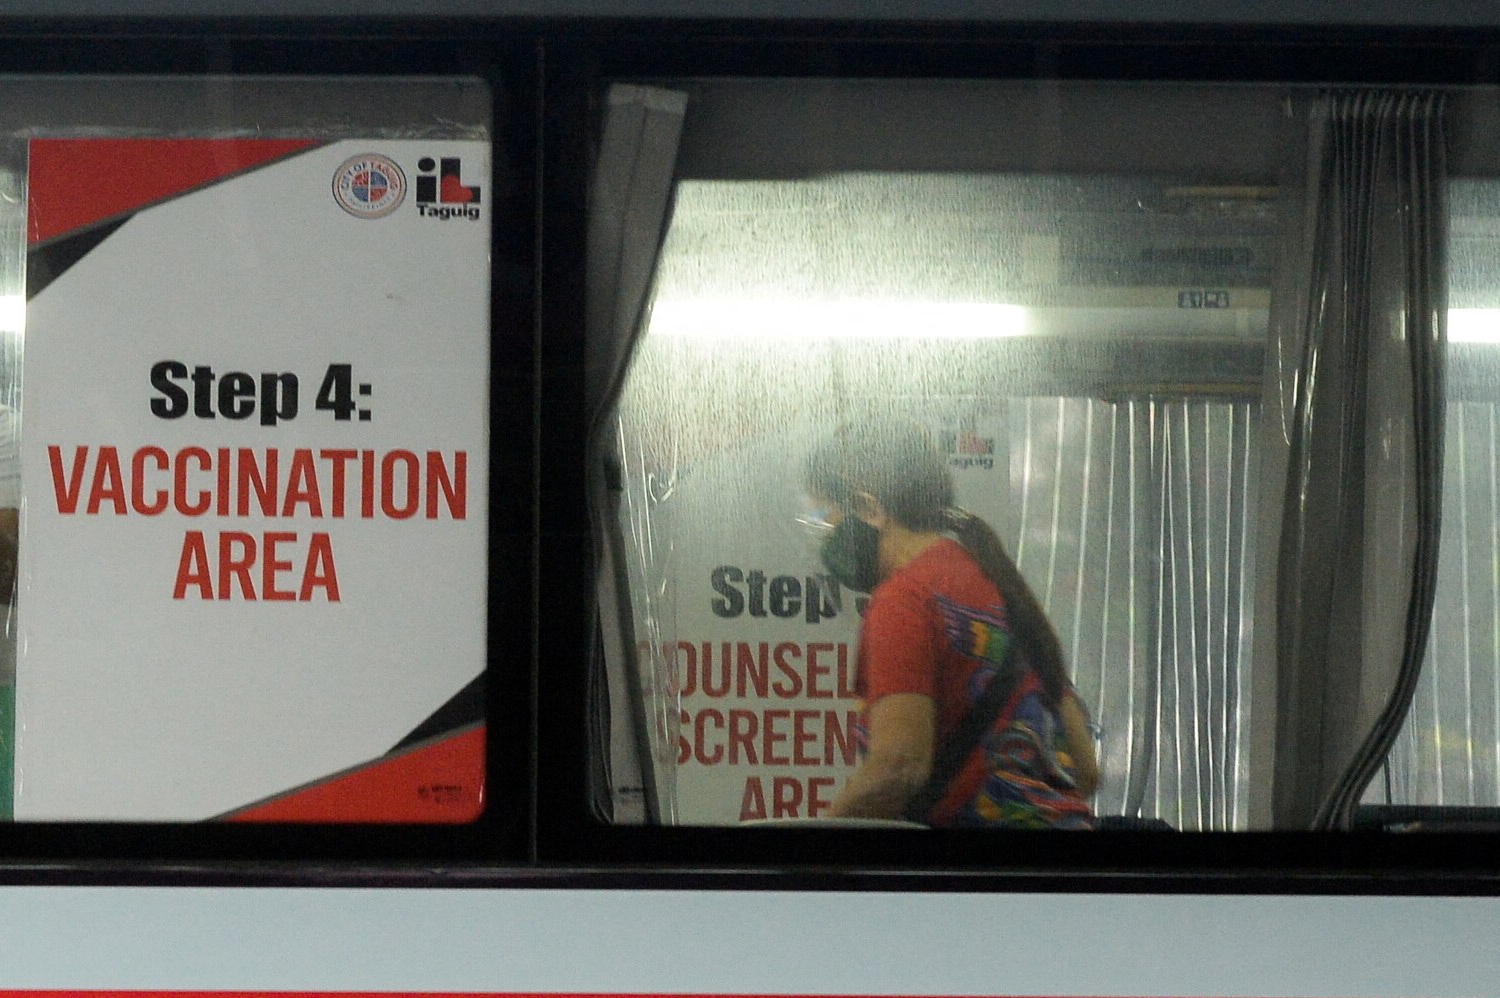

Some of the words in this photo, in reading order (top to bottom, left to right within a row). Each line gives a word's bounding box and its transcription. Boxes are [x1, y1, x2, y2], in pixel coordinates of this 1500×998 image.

[416, 203, 480, 220] Taguig
[150, 361, 299, 427] Step
[315, 364, 372, 421] 4:
[47, 445, 468, 520] VACCINATION
[172, 531, 342, 603] AREA
[711, 566, 842, 624] Step
